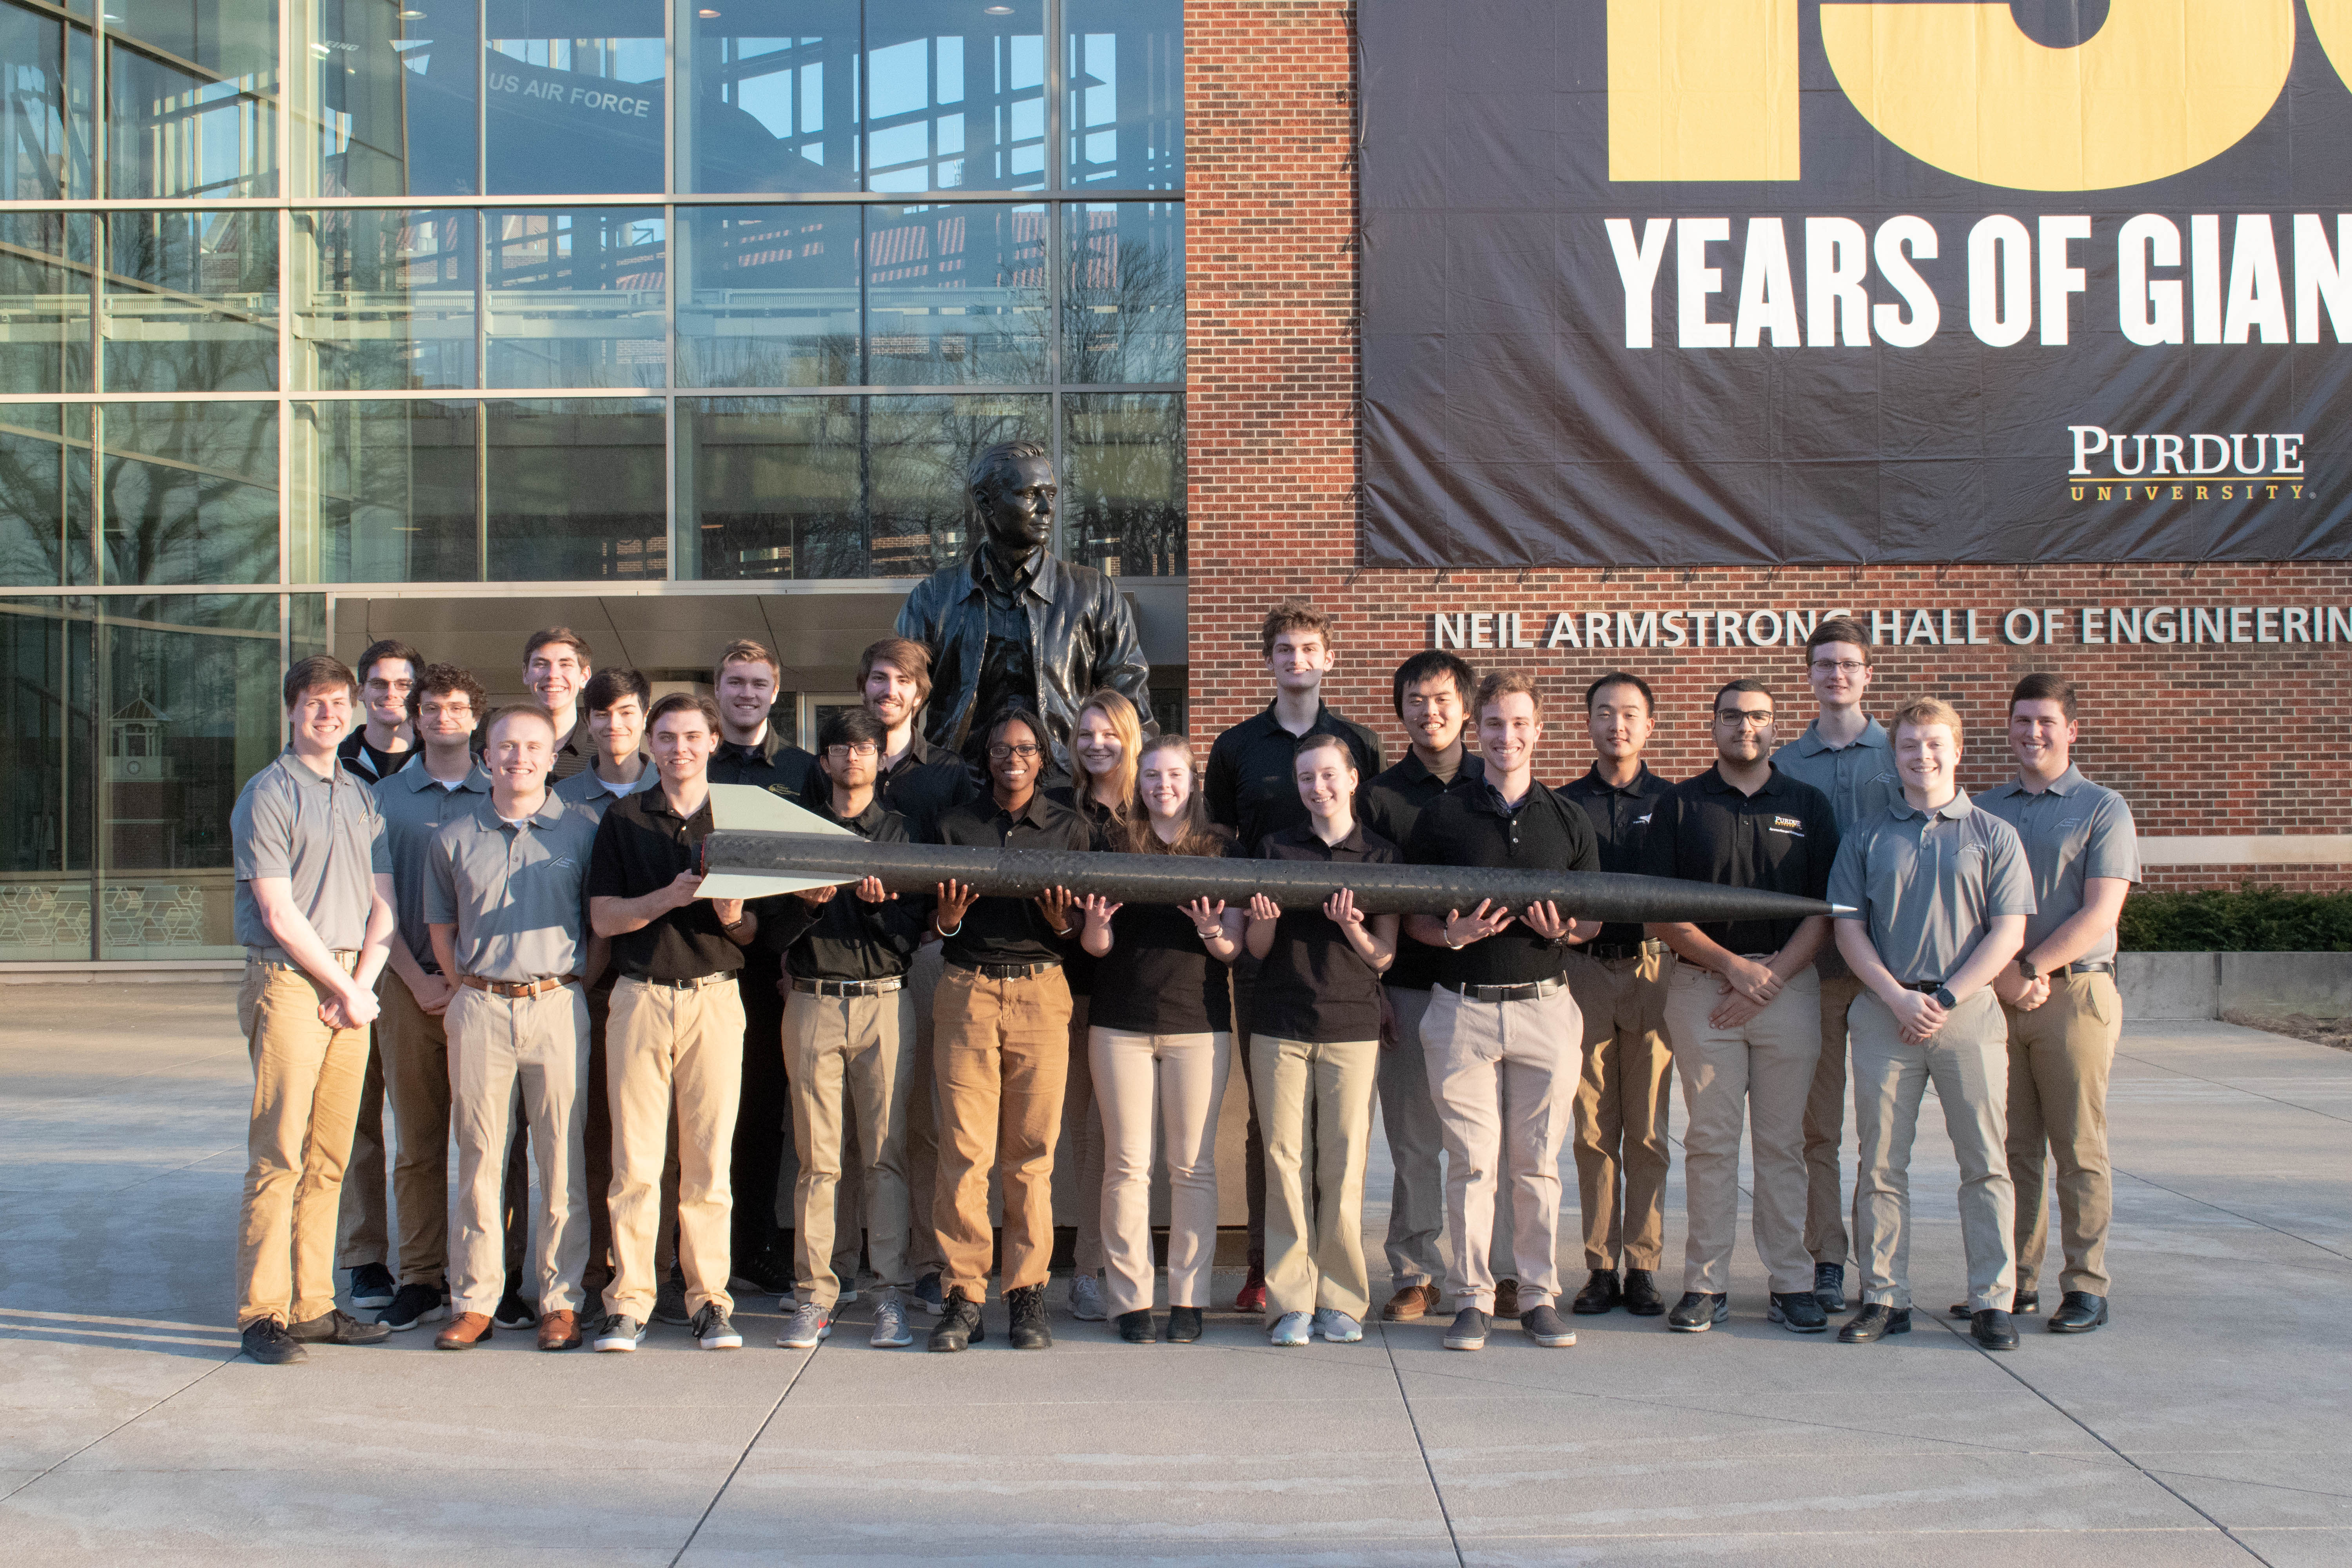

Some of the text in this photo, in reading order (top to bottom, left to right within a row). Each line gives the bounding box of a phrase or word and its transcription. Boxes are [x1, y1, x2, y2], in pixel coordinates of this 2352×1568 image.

[488, 73, 651, 118] US AIR FORCE
[1604, 213, 2352, 348] YEARS OF GIAN
[2067, 426, 2304, 475] PURDUE
[2071, 485, 2304, 501] UNIVERSITY
[1435, 606, 2352, 648] NEIL ARMSTRON HALL OF ENGINEERIN
[1775, 816, 1801, 826] PURDUE
